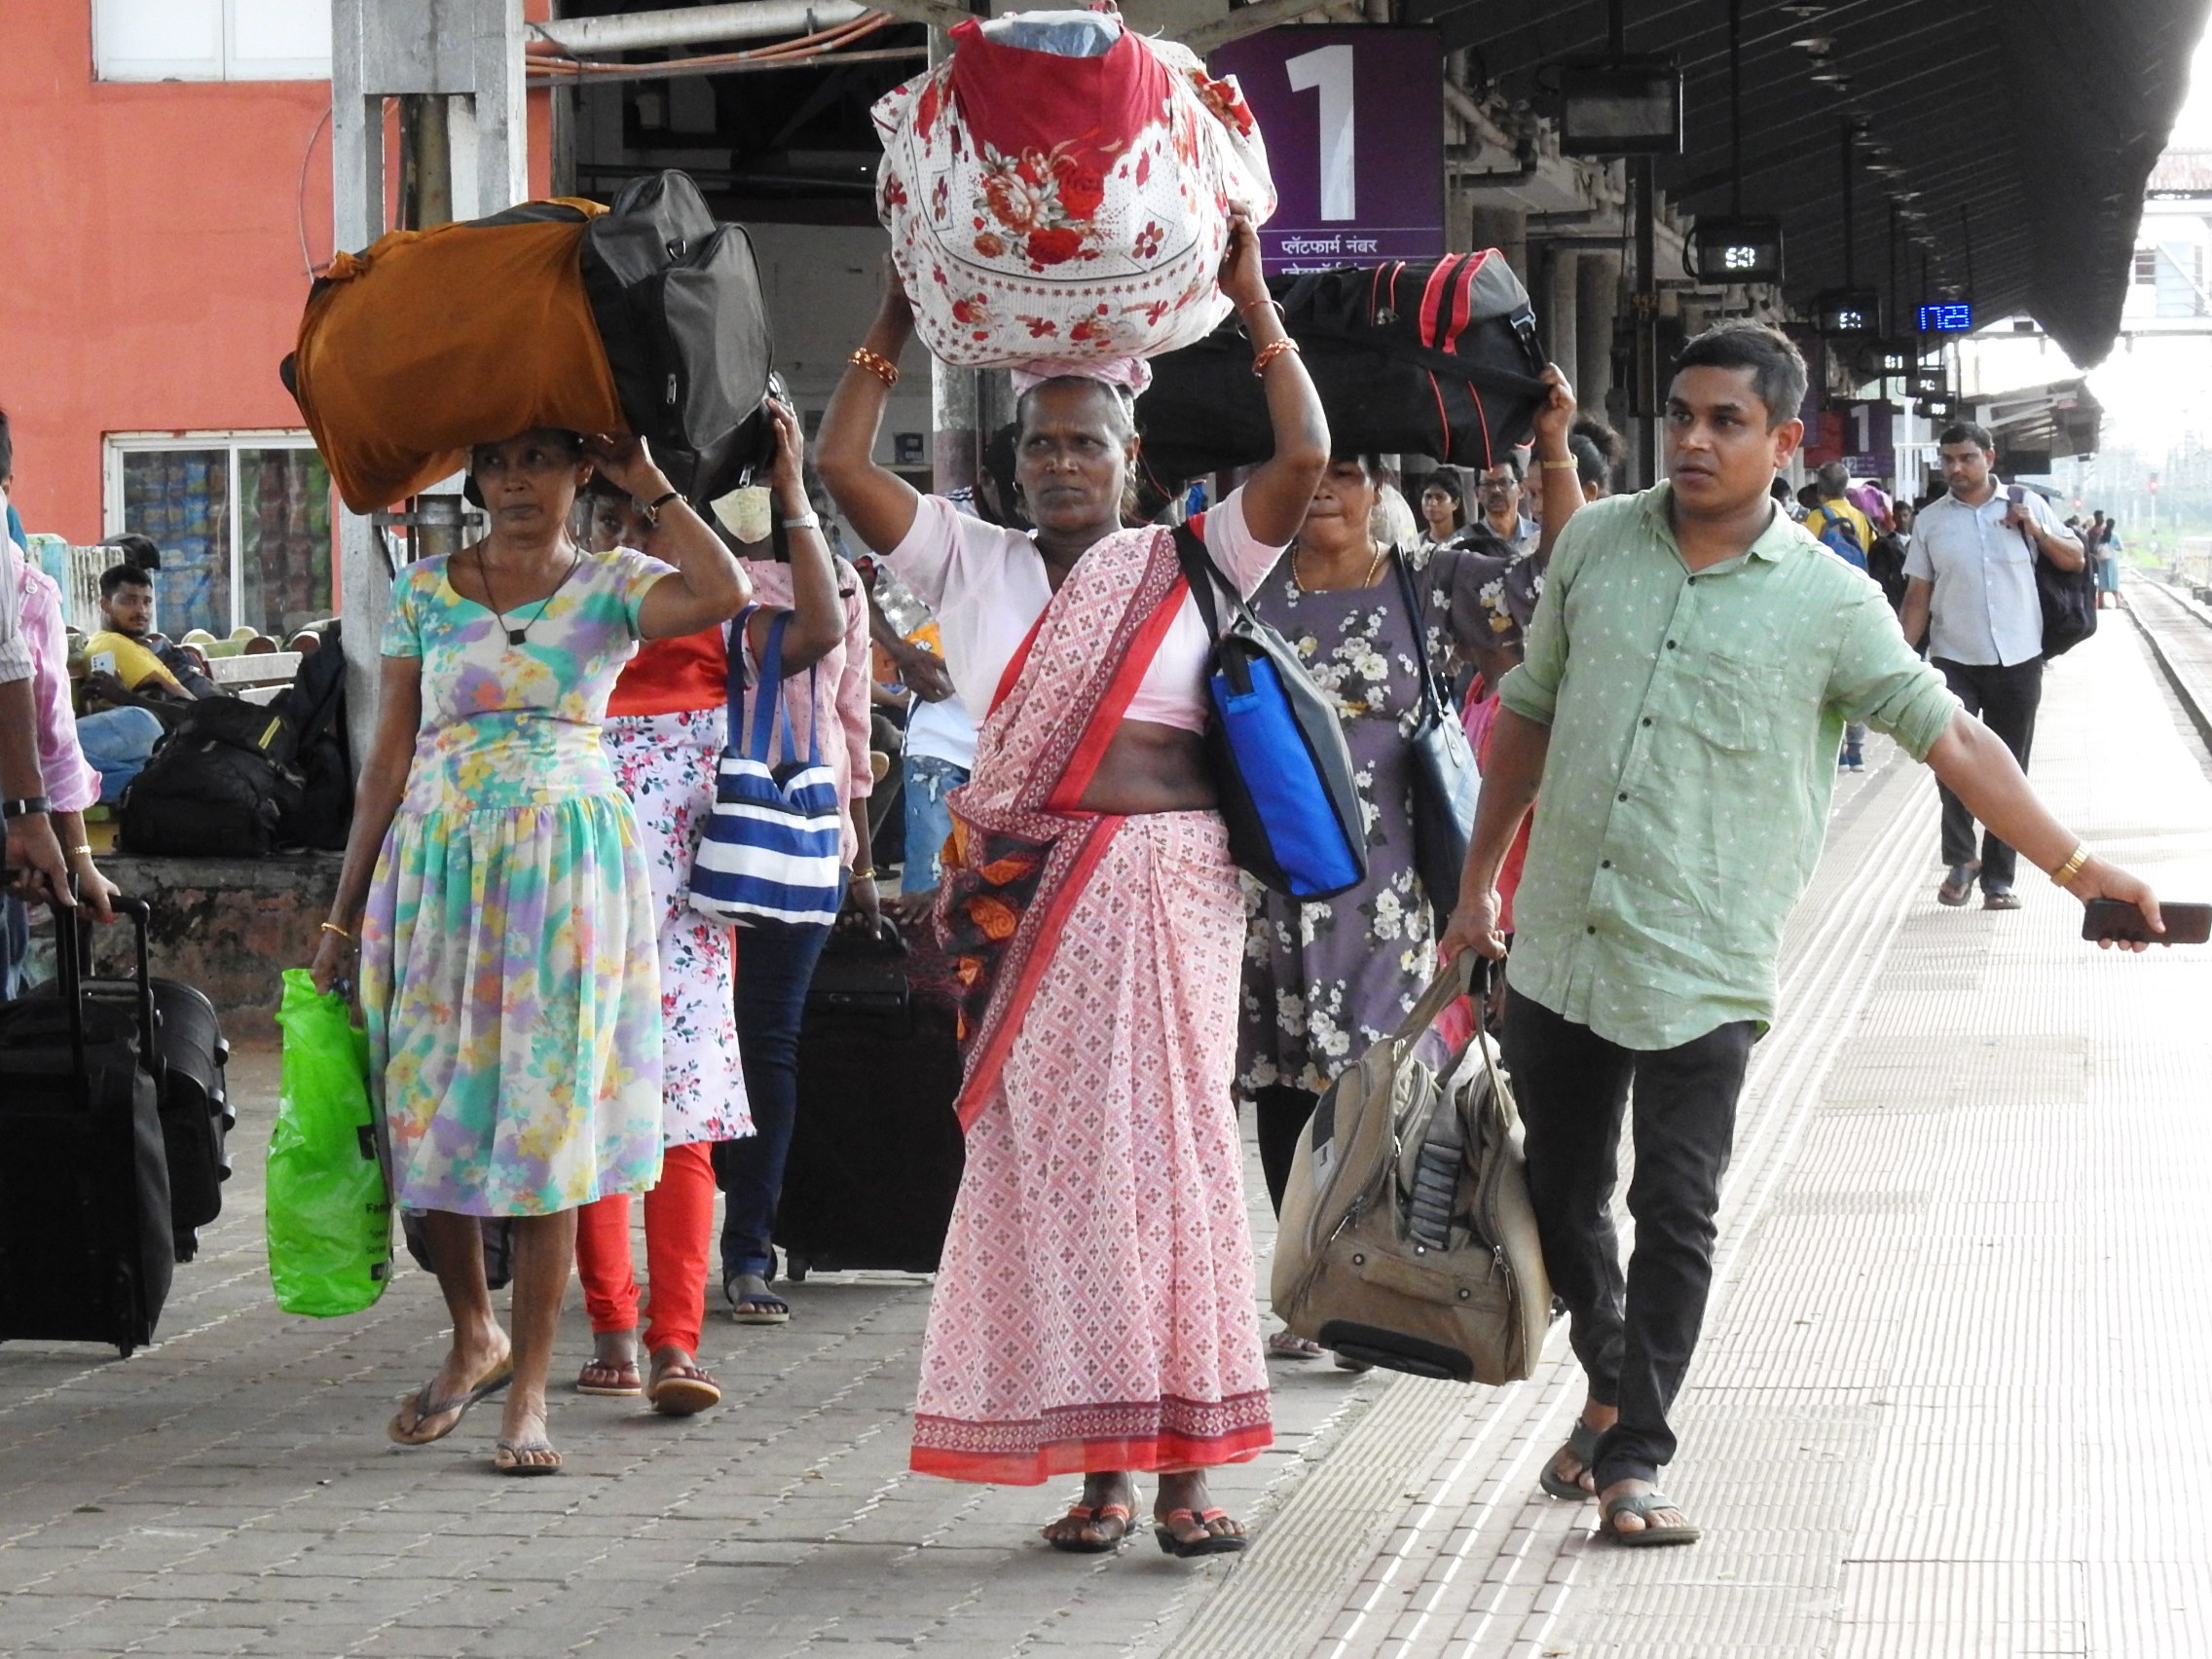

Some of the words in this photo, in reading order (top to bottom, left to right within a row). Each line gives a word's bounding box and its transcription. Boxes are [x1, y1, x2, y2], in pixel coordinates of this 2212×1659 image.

[1285, 45, 1355, 220] 1
[1346, 236, 1378, 253] नंबर
[1850, 404, 1869, 453] 1
